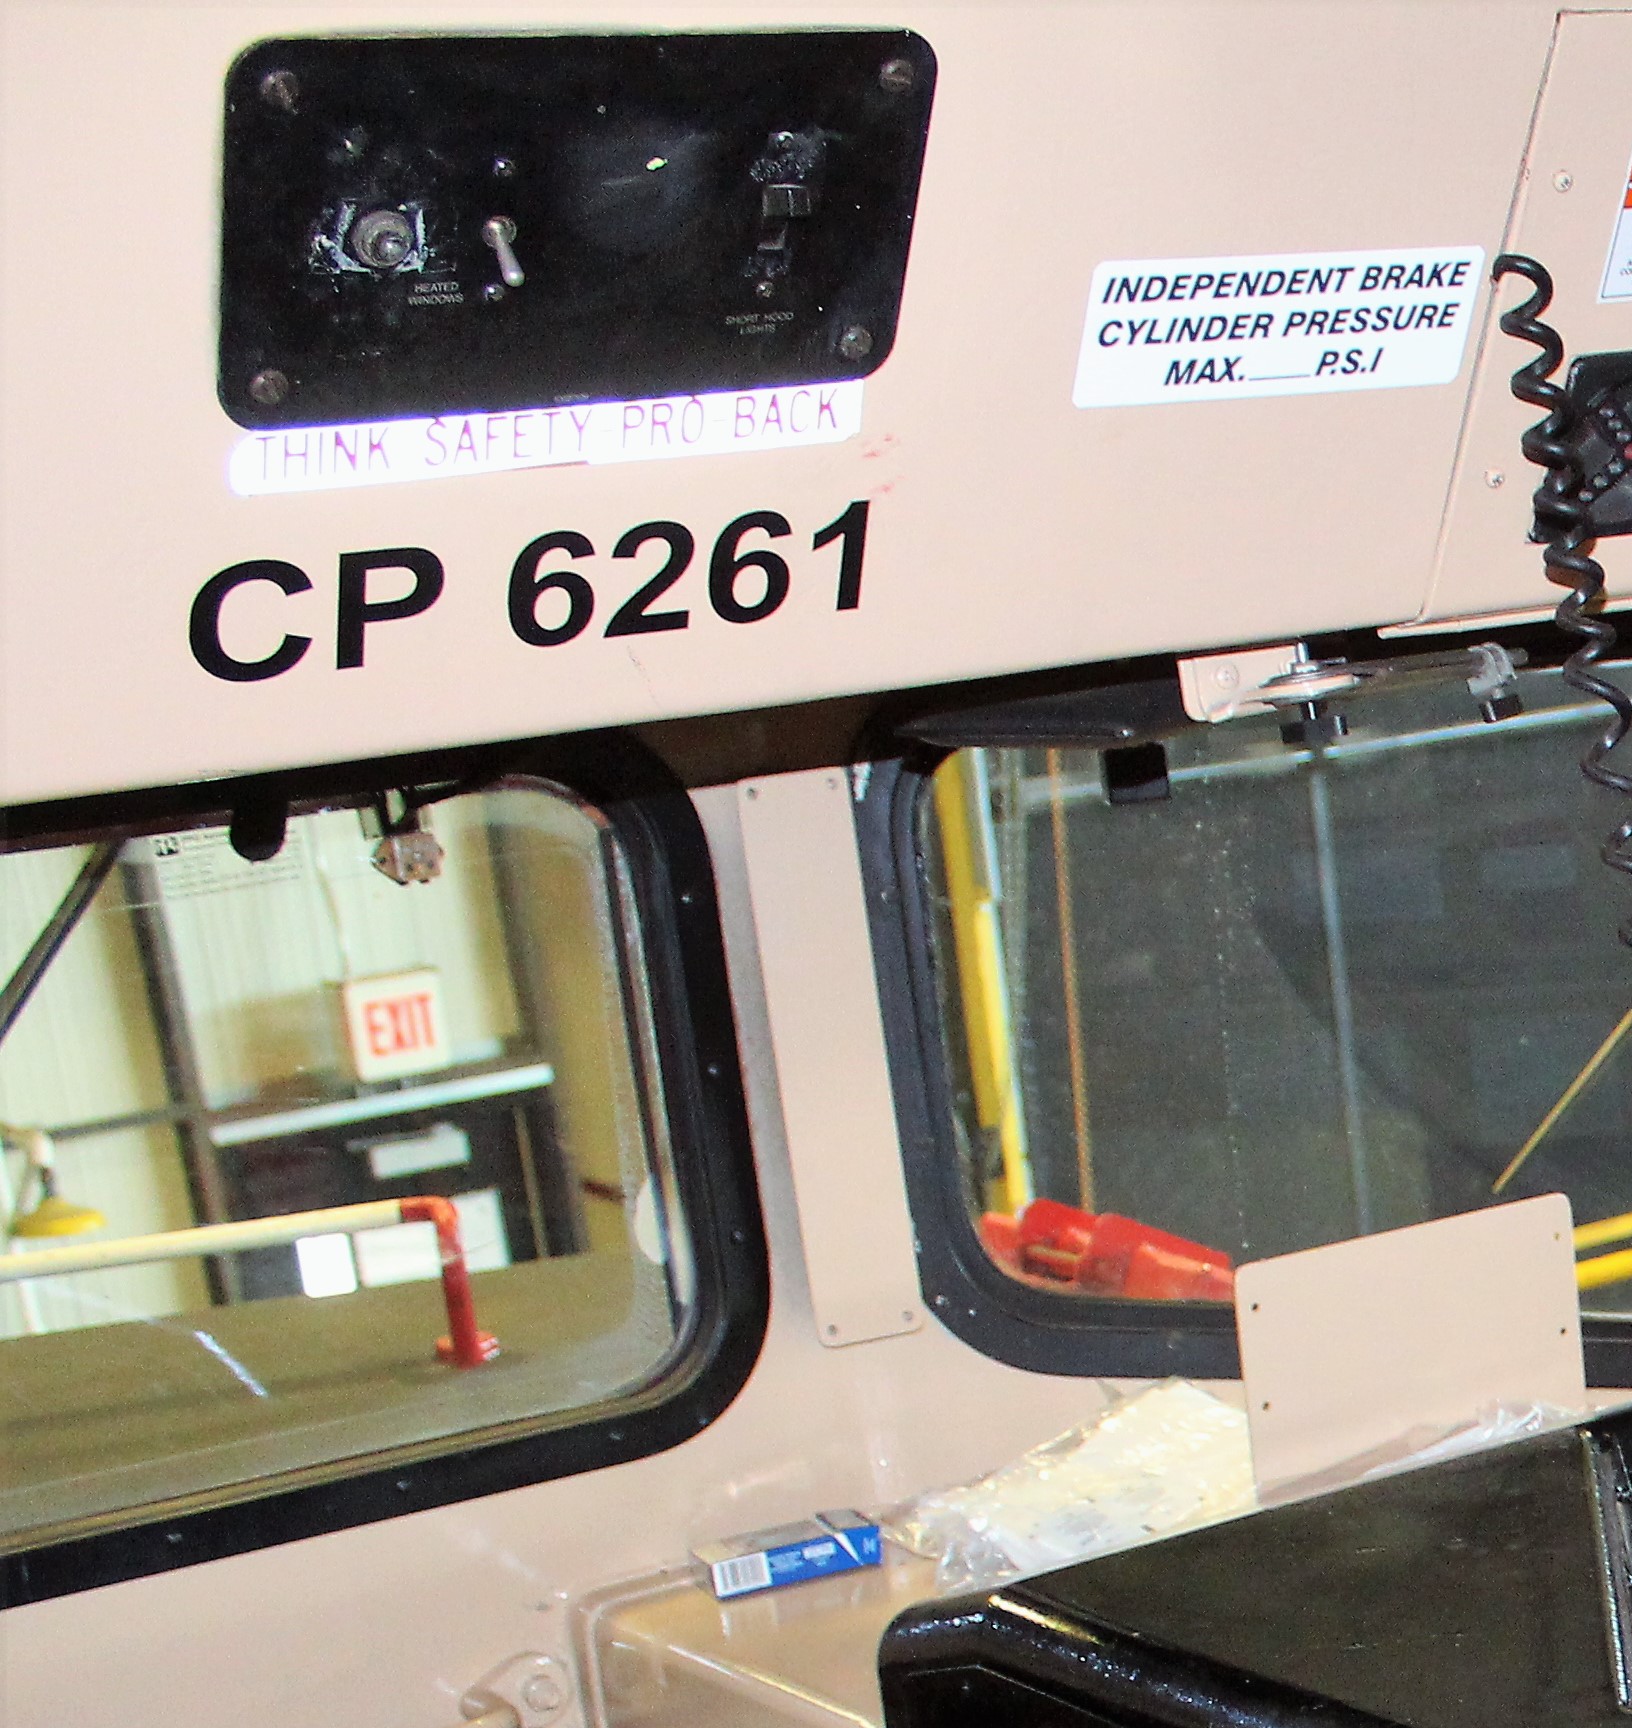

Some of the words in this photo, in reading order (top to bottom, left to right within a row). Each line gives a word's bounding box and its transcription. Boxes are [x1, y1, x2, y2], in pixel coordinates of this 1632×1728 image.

[1101, 267, 1355, 304] INDEPENDENT
[1358, 261, 1471, 292] BRAKE
[1098, 313, 1275, 348] CYLINDER
[1282, 303, 1460, 337] PRESSURE
[256, 426, 392, 481] THINK
[424, 409, 593, 466] SAFETY
[733, 388, 839, 438] BACK
[188, 546, 445, 683] CP
[507, 499, 871, 648] 6261
[363, 991, 436, 1058] EXIT
